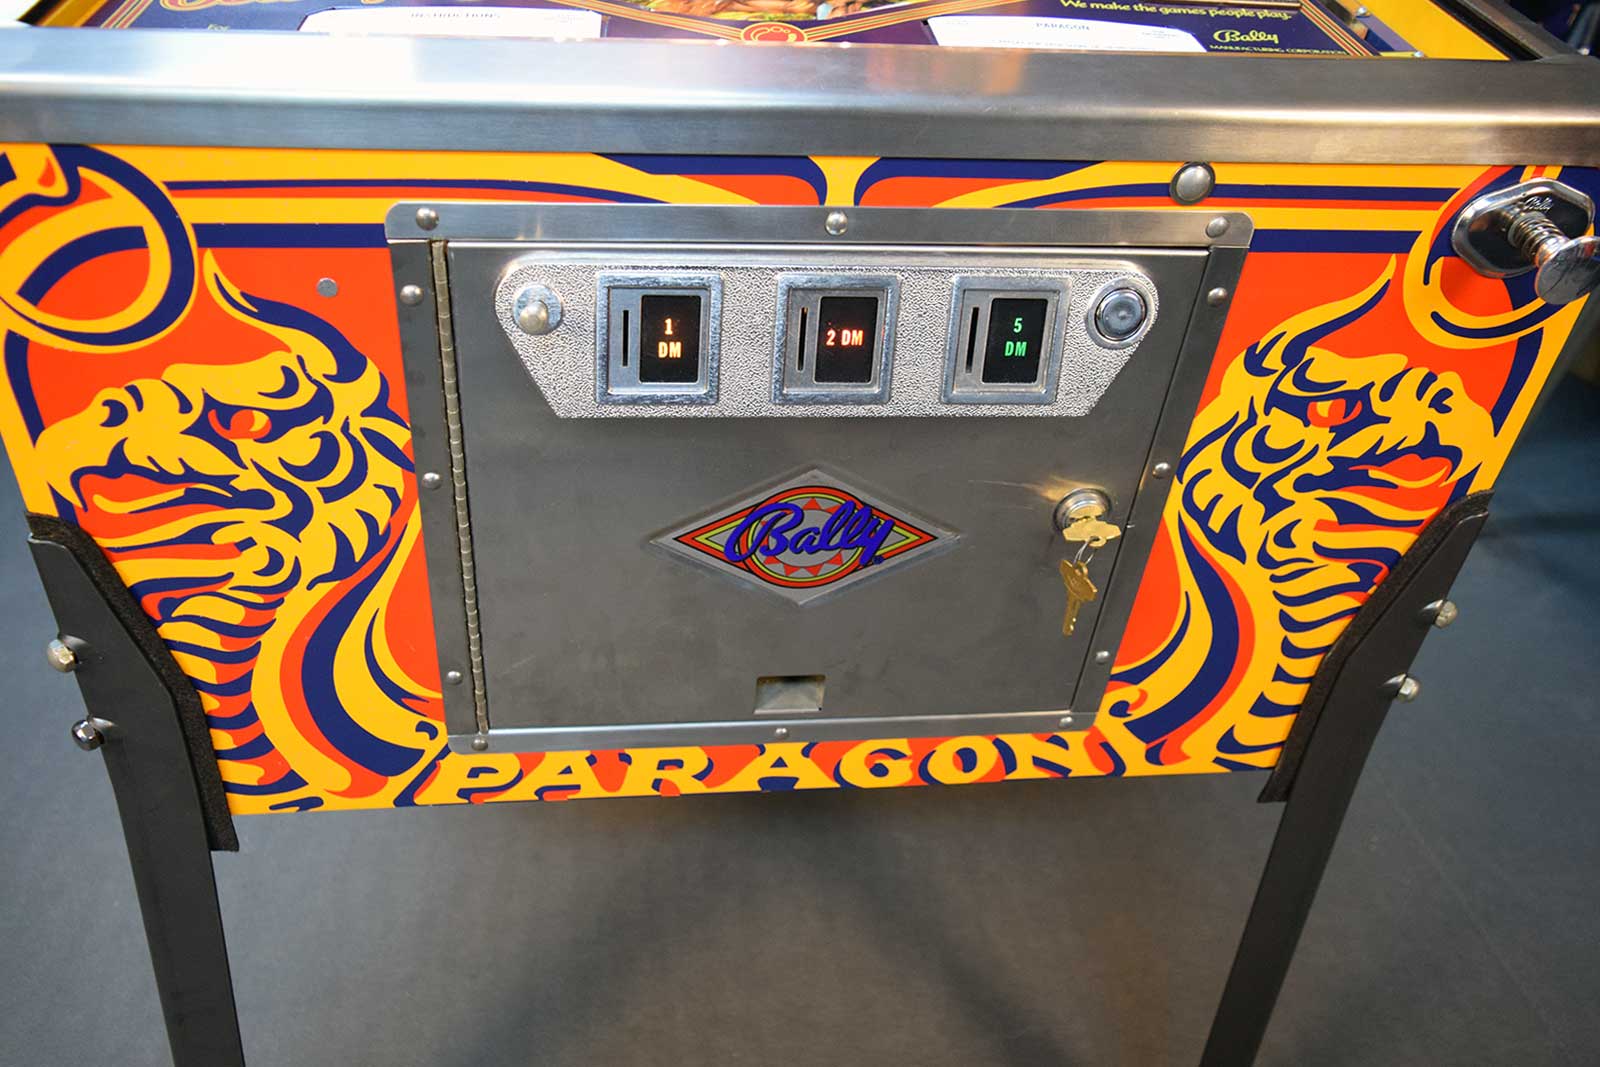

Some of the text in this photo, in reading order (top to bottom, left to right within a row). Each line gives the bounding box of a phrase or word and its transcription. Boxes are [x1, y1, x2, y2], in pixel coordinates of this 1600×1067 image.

[1060, 0, 1292, 20] We make the games people play.
[1036, 22, 1091, 31] PARAGON
[1213, 29, 1279, 44] Bally
[664, 317, 673, 335] 1
[1013, 317, 1023, 333] 5
[826, 328, 864, 346] 2 DM
[658, 341, 682, 359] DM
[1004, 340, 1027, 357] DM
[724, 500, 896, 567] Bally
[412, 730, 1103, 806] PARAGON
